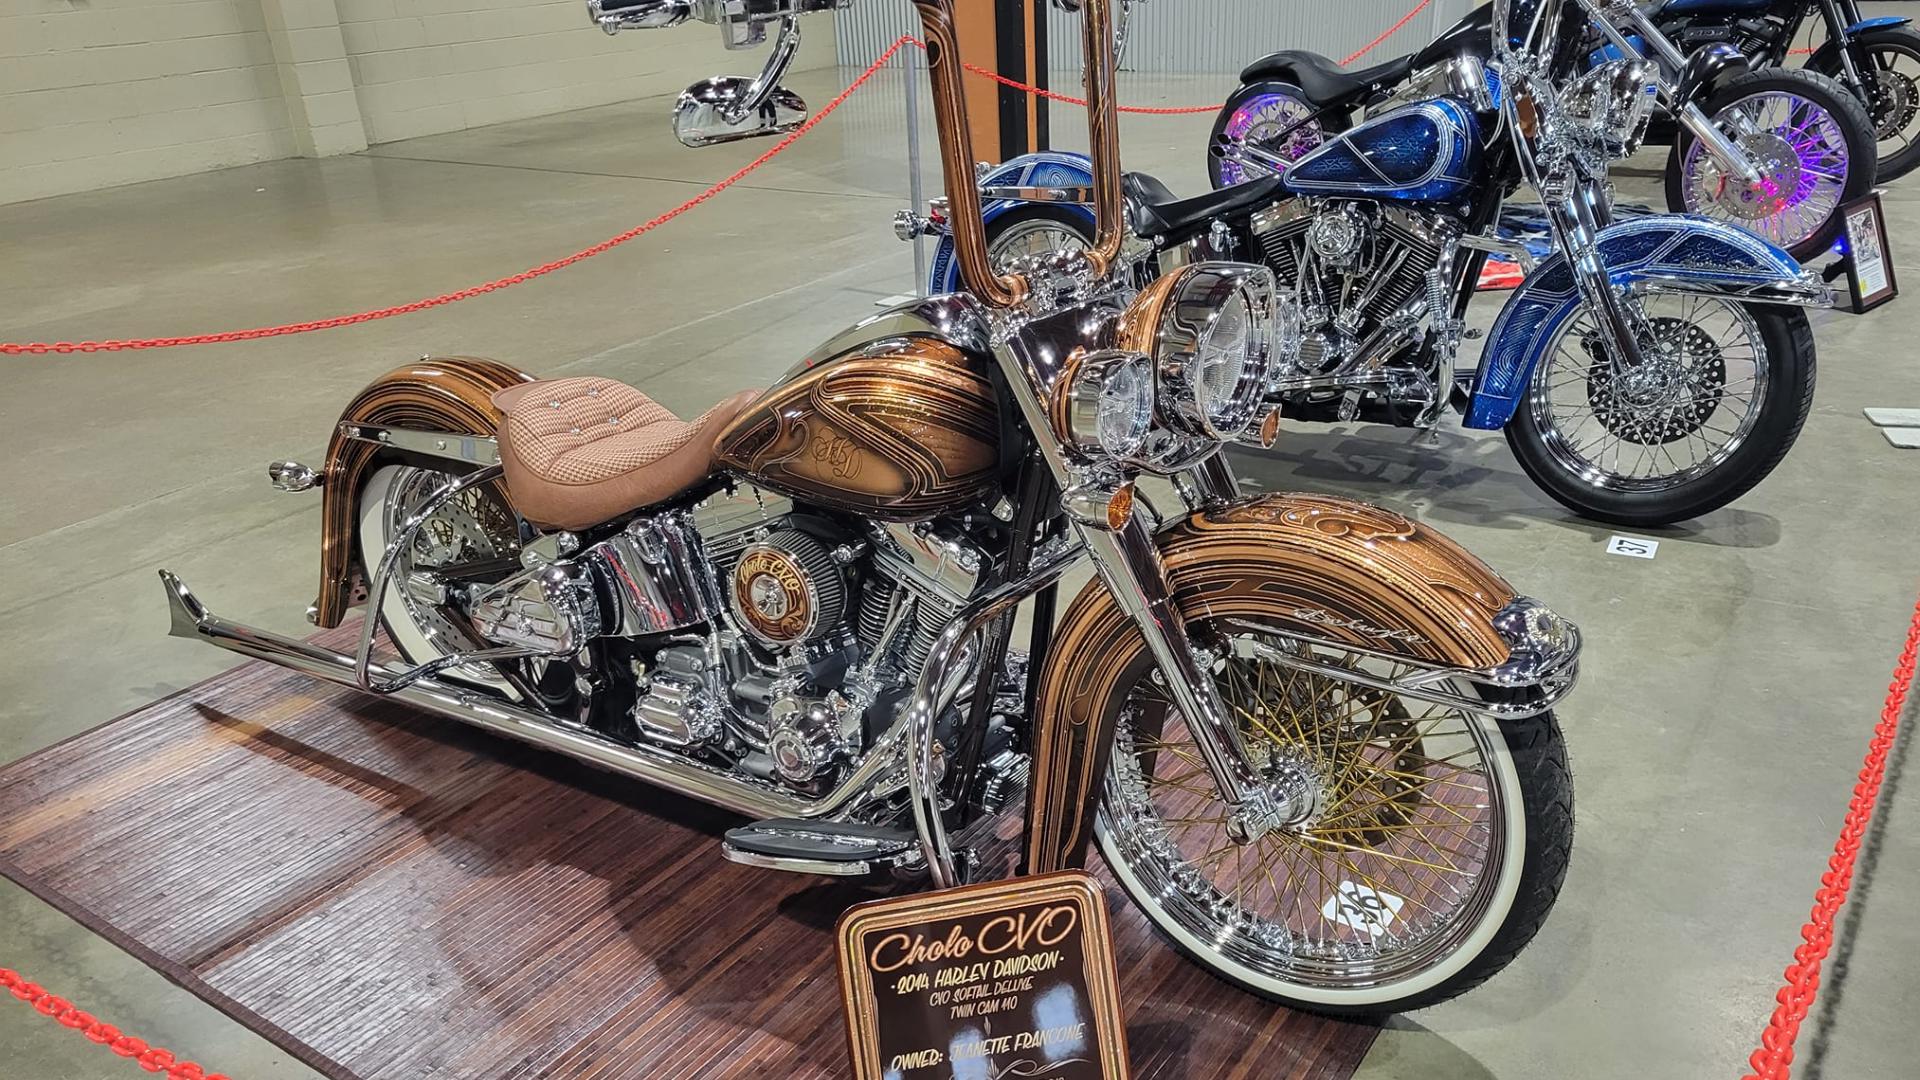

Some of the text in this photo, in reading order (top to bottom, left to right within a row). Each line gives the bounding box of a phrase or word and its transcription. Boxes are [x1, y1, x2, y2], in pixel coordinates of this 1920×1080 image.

[1616, 540, 1649, 555] 37
[1338, 891, 1388, 924] 36
[870, 905, 1077, 972] Cholo CVO
[934, 961, 991, 989] HARLEY
[929, 975, 1034, 1007] CVO SOFTAIL DELUXE
[950, 995, 1019, 1020] TWIN CAM 110
[891, 1048, 944, 1072] OWNER:
